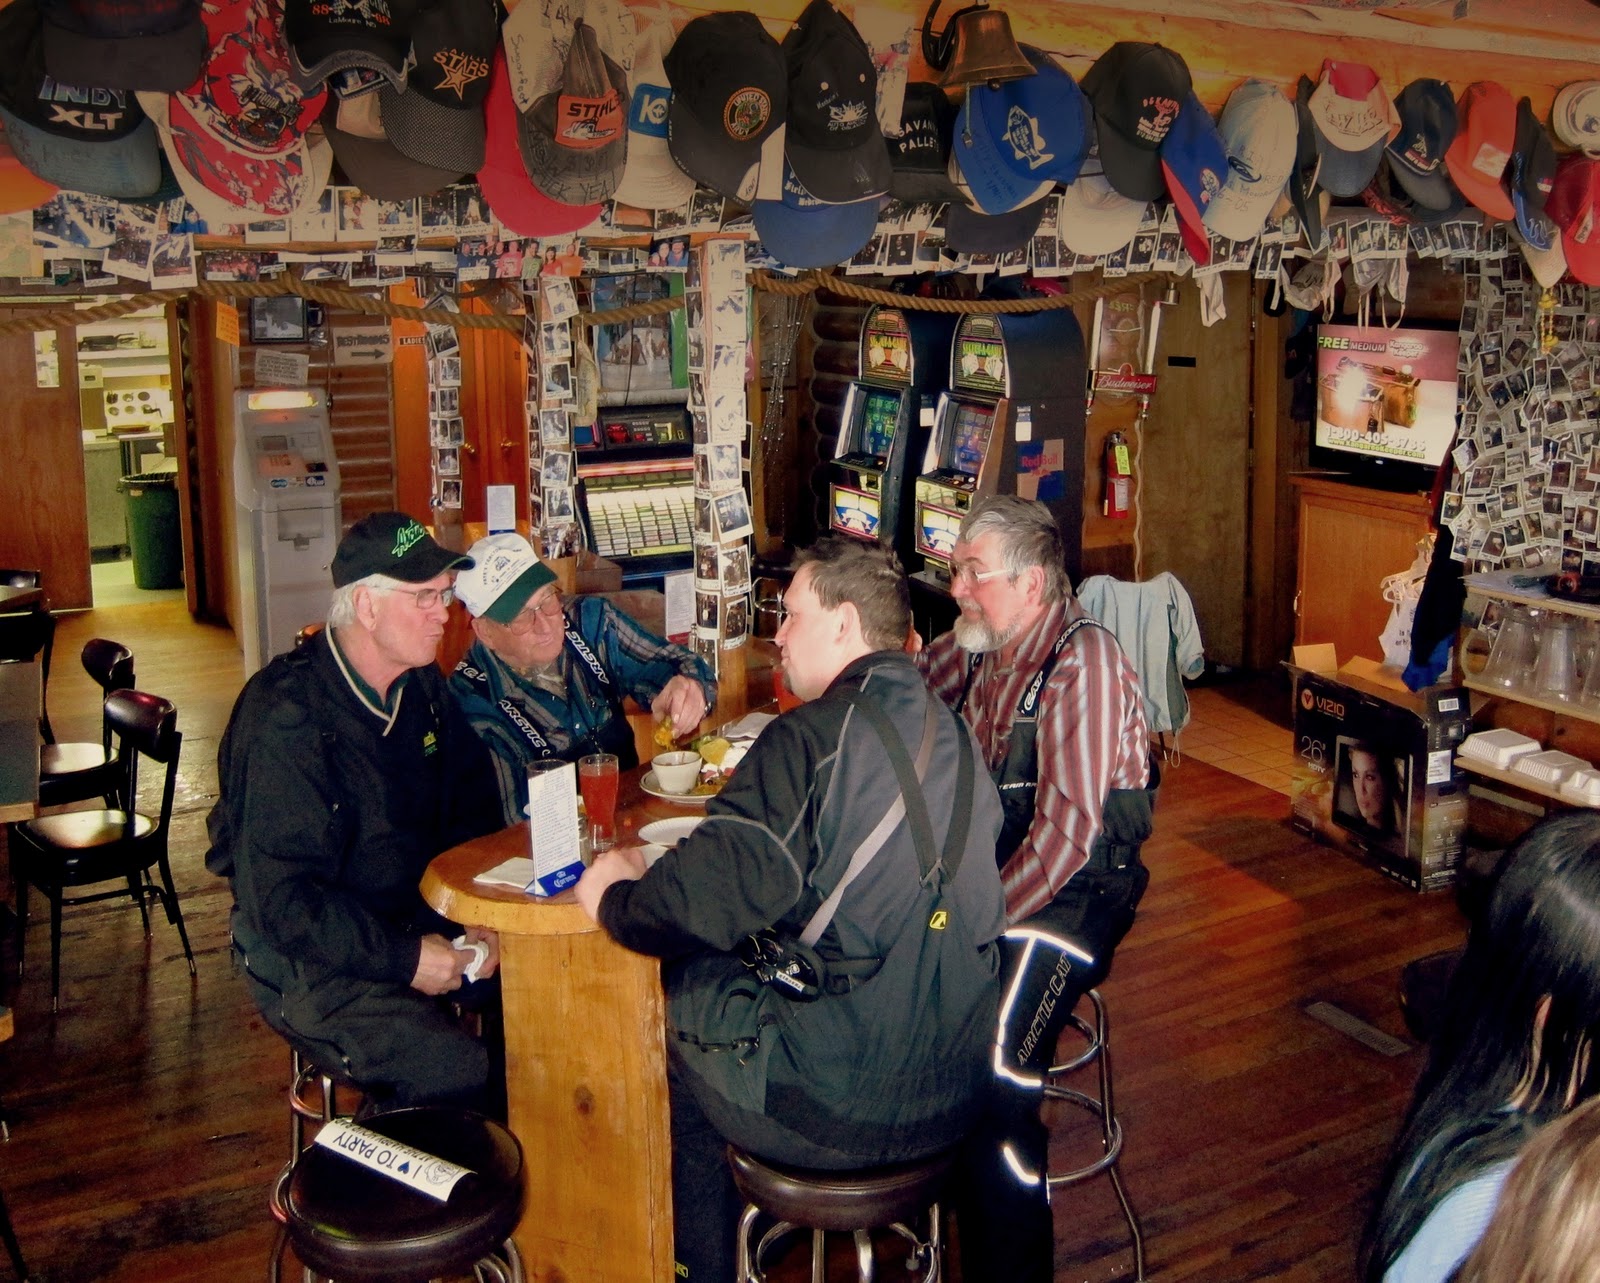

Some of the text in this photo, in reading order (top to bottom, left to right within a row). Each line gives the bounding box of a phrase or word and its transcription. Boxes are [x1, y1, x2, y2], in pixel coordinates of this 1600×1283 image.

[312, 4, 329, 15] 88
[433, 51, 490, 78] STARS
[38, 74, 127, 109] INDY
[48, 103, 123, 130] XLT
[567, 98, 617, 118] STIHL
[1318, 336, 1350, 350] FREE
[1350, 341, 1387, 353] MEDIUM
[1097, 375, 1153, 390] Budweiser
[1021, 453, 1058, 468] Red Bull
[565, 630, 610, 685] ARCTIC
[1024, 670, 1044, 711] CAT
[1316, 695, 1345, 718] VIZIO
[499, 699, 548, 749] ARCTIC
[1308, 761, 1326, 774] HDTV
[999, 782, 1024, 791] TEAM
[553, 874, 577, 888] Corona
[1017, 951, 1072, 1066] ARCTIC CAT
[332, 1130, 377, 1160] PARTY
[376, 1149, 399, 1169] TO
